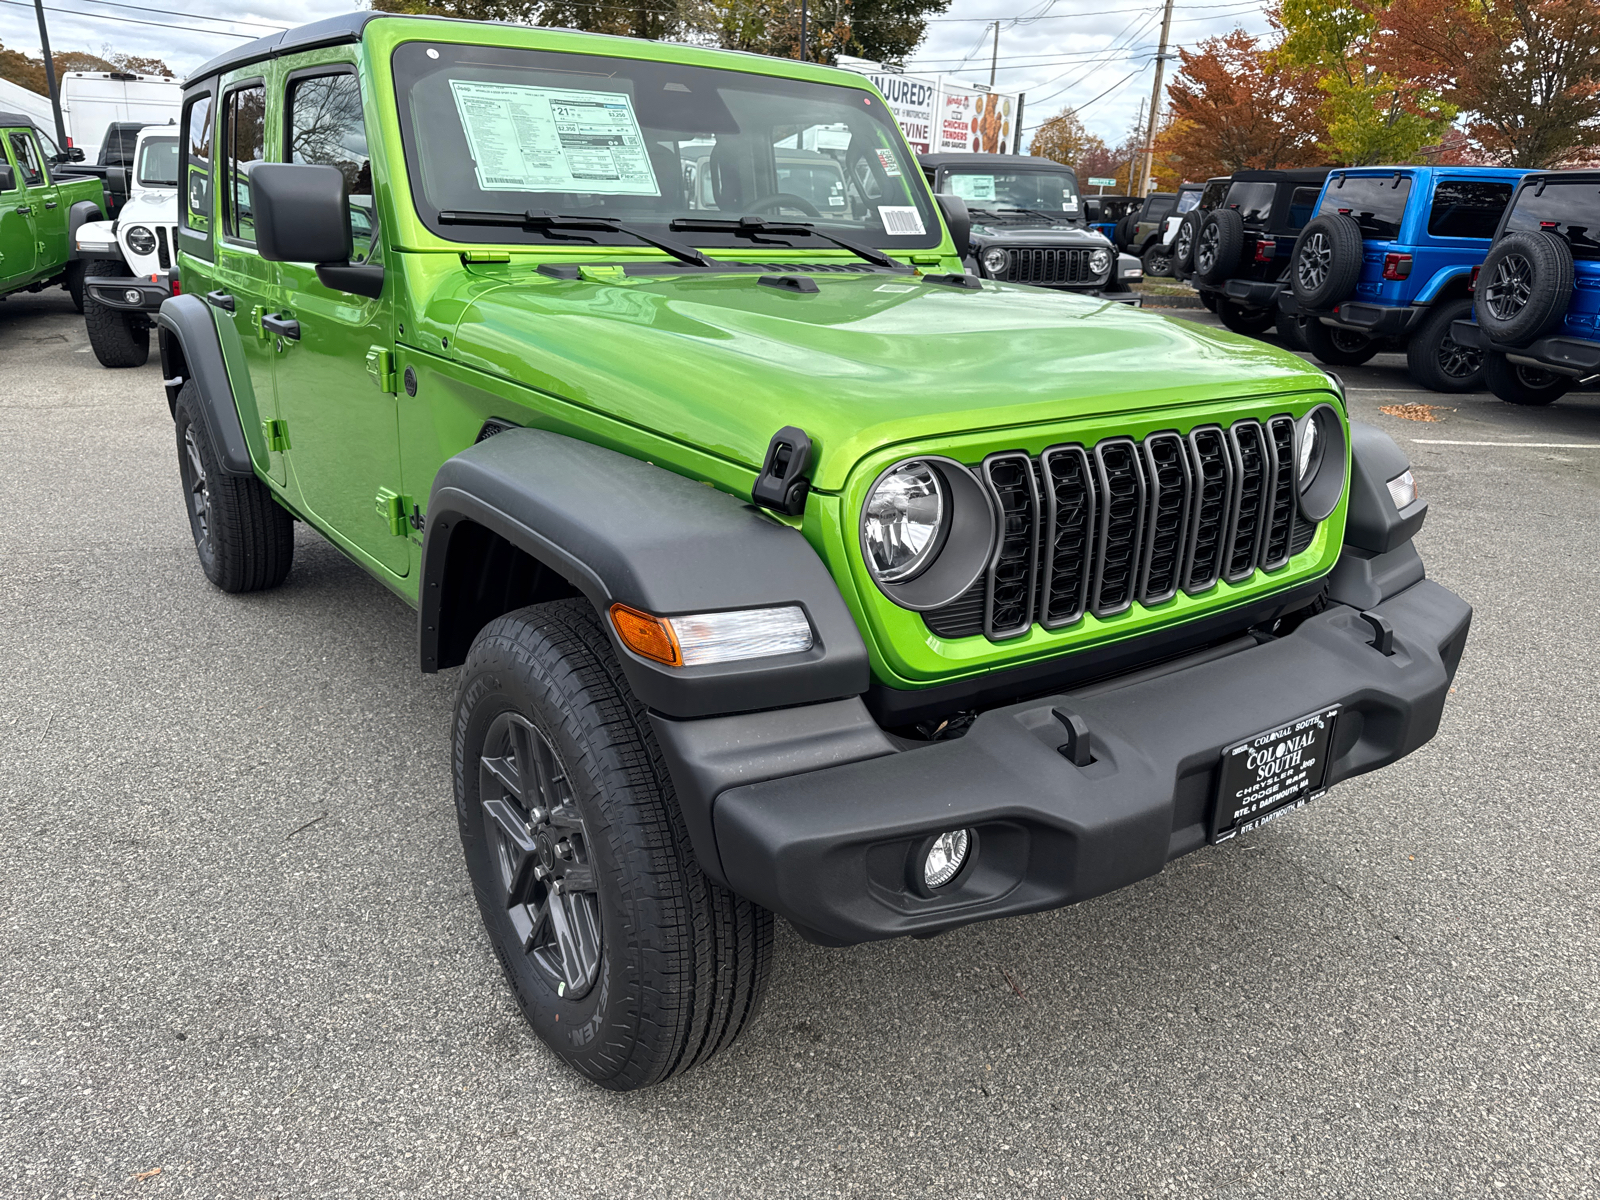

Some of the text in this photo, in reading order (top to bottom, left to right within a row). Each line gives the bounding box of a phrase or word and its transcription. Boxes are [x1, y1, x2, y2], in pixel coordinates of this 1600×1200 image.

[870, 76, 932, 107] NJURED?
[557, 107, 569, 116] 21
[943, 120, 968, 131] CHICKEN
[942, 130, 968, 141] TENDERS
[456, 703, 470, 819] ROADIAN
[466, 676, 490, 710] HTX
[1254, 715, 1320, 747] COLONIAL SOUTH
[1246, 730, 1315, 770] COLONIAL
[1256, 749, 1302, 781] SOUTH
[1236, 758, 1316, 798] CHRYSLER Jeep
[1242, 771, 1306, 804] DODGE RAM
[1234, 807, 1250, 818] RTE.
[1299, 779, 1308, 788] MA
[1240, 823, 1254, 834] RTE.
[1297, 799, 1305, 808] MA
[572, 954, 610, 1046] NEXEN
